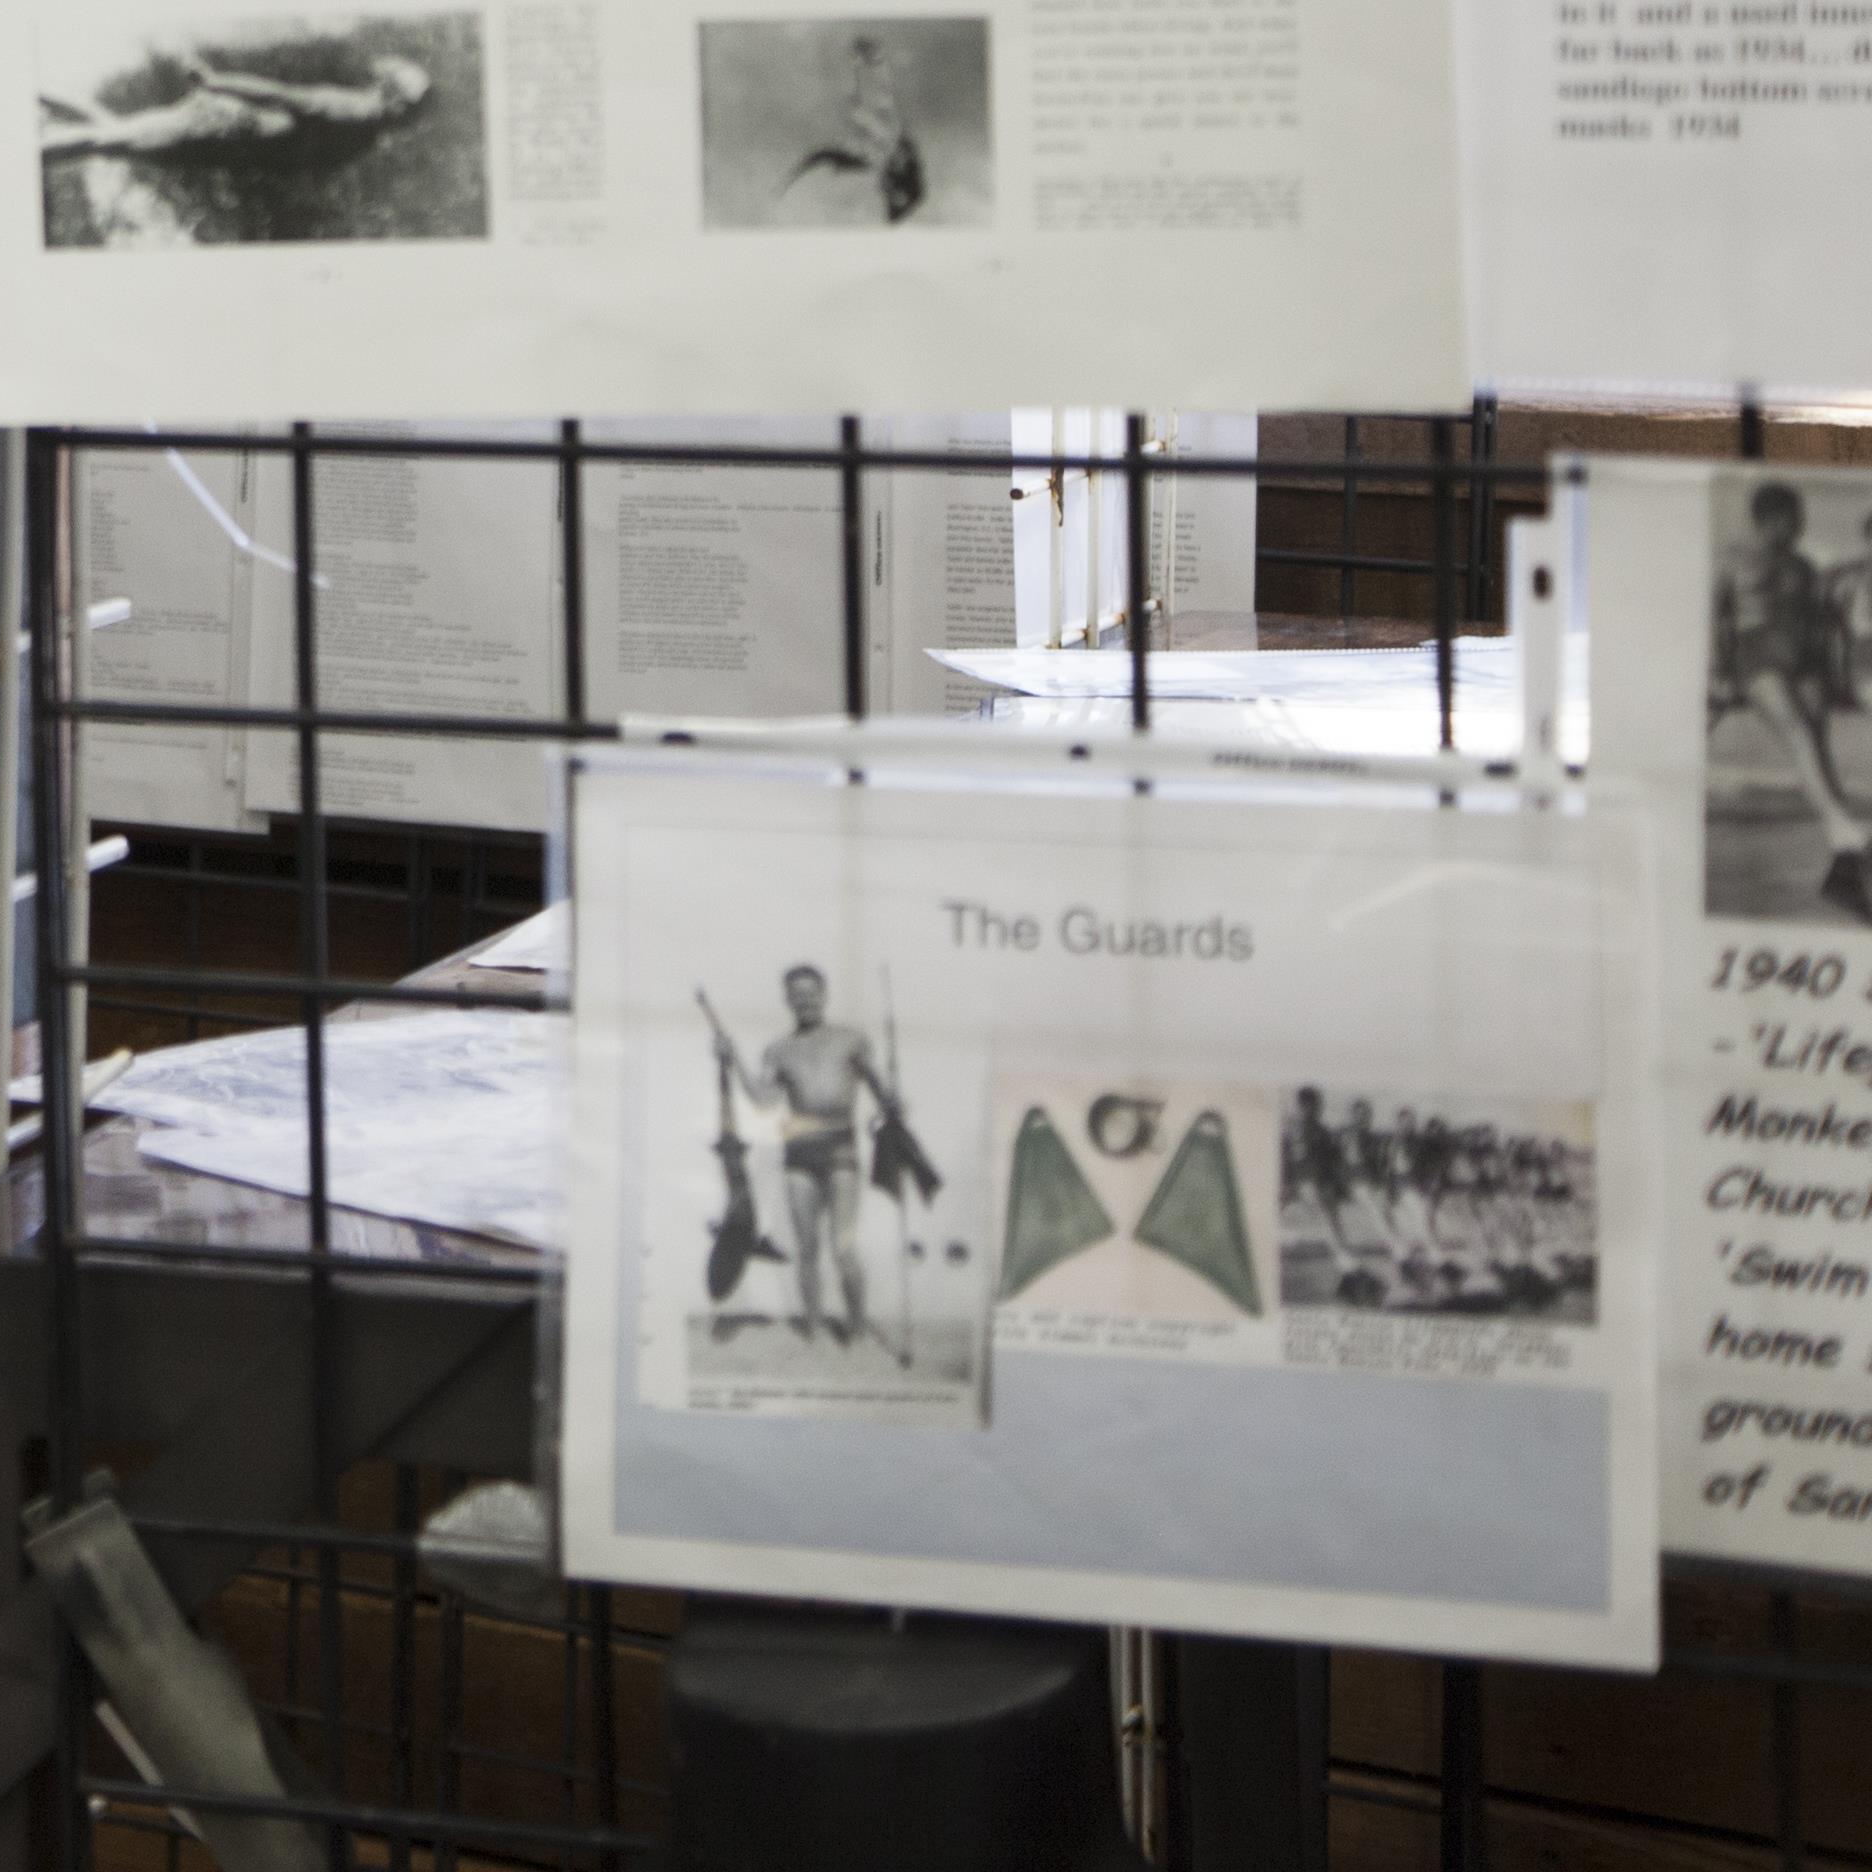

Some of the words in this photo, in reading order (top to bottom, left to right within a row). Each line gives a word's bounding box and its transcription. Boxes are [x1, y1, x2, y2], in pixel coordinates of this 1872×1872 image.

[940, 898, 1040, 951] The
[1060, 904, 1255, 961] Guards
[1712, 944, 1848, 998] 1940
[1707, 1315, 1842, 1368] home
[1704, 1460, 1771, 1510] of
